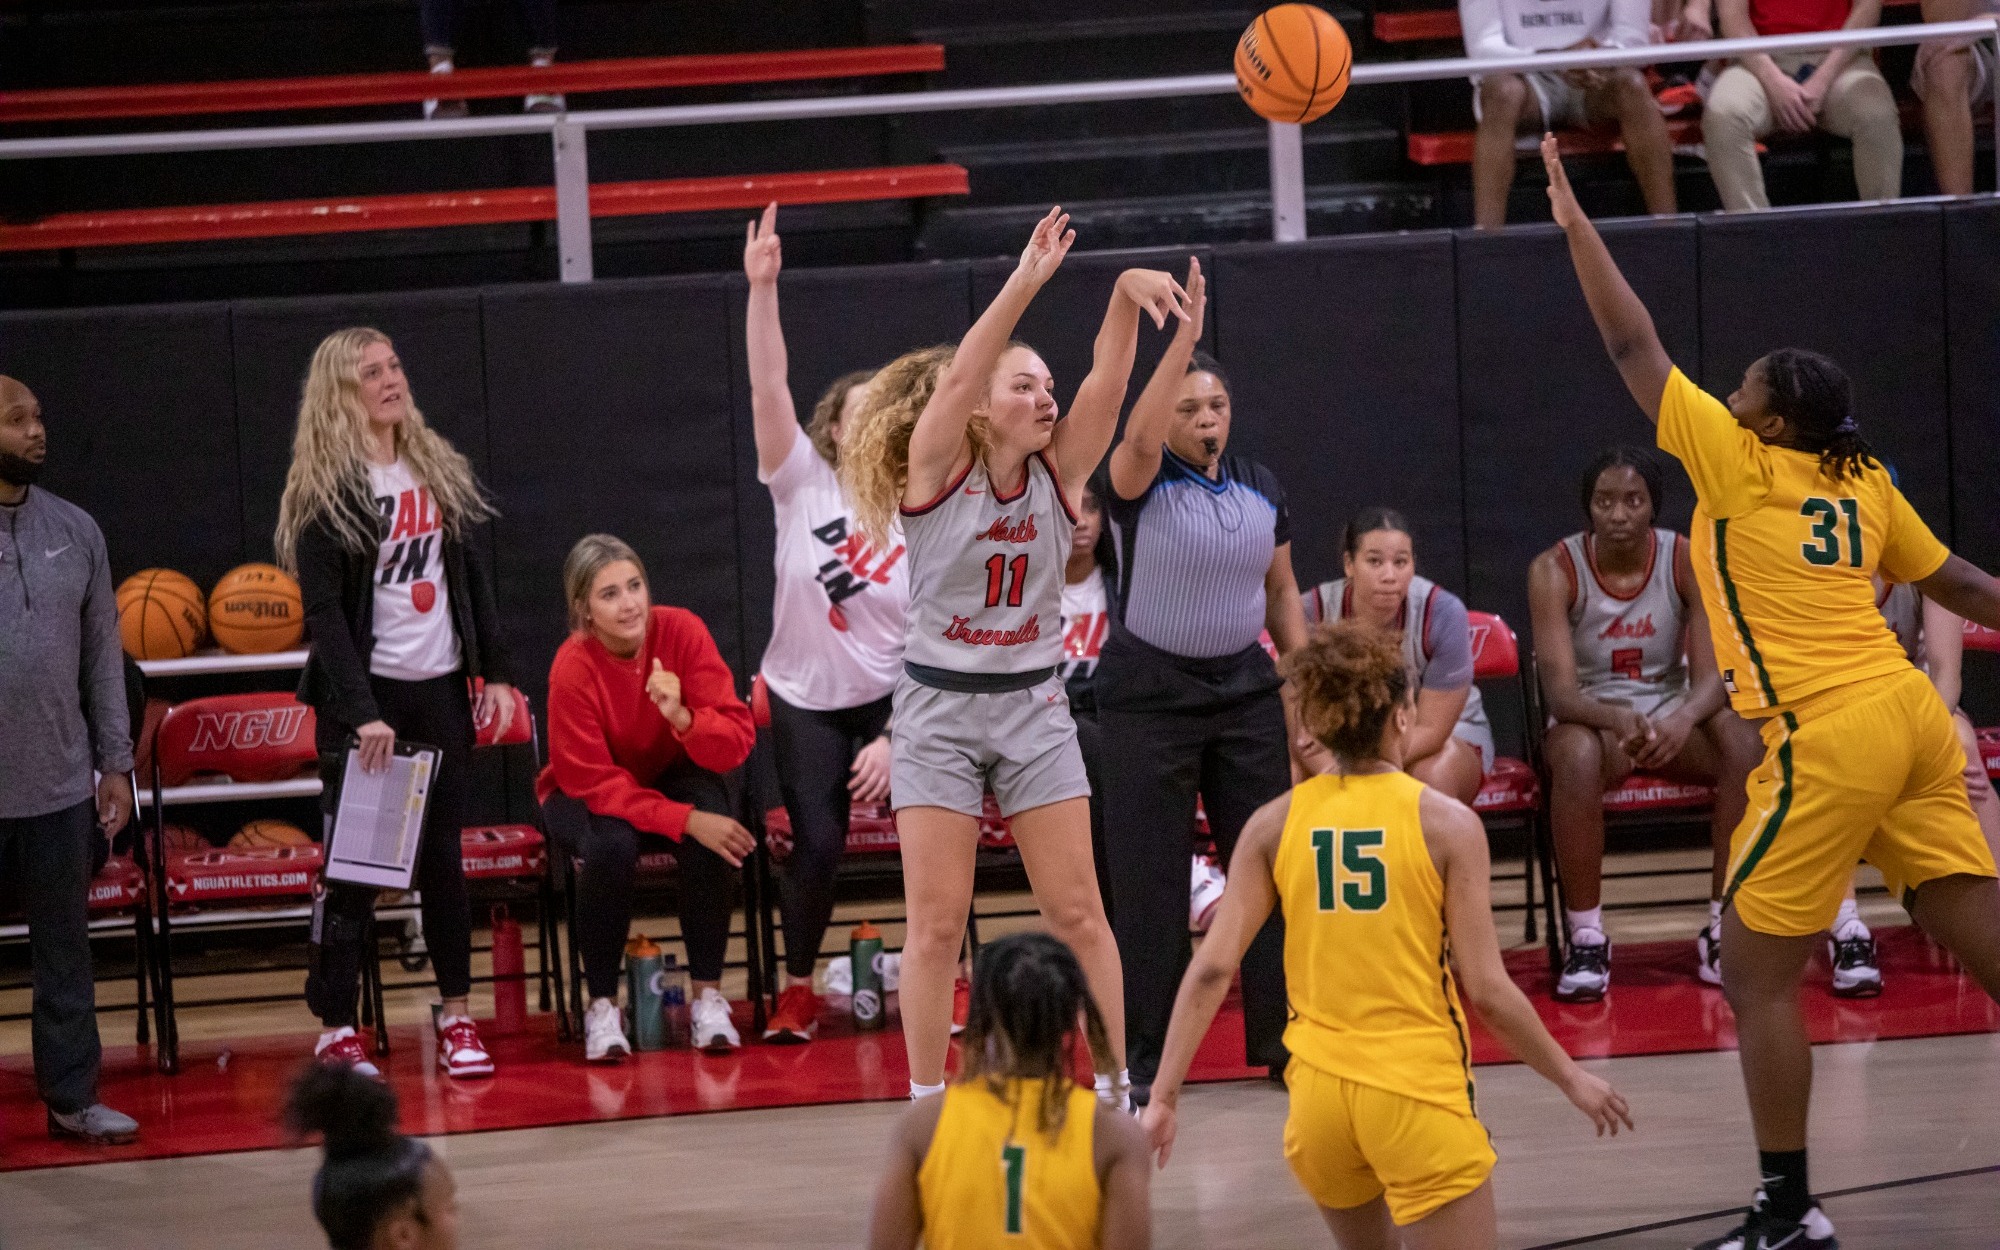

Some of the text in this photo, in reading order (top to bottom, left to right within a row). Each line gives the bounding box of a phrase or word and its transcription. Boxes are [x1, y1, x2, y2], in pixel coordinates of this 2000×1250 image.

[976, 513, 1038, 544] North
[1800, 496, 1864, 569] 31
[380, 534, 435, 585] IN
[984, 552, 1029, 609] 11
[224, 601, 290, 619] Wilson
[941, 613, 1041, 647] Greenville
[1611, 647, 1644, 680] 5
[188, 705, 308, 752] NGU
[193, 872, 308, 891] NGUATHLETICS.COM
[1310, 827, 1388, 914] 15
[1002, 1142, 1025, 1234] 1
